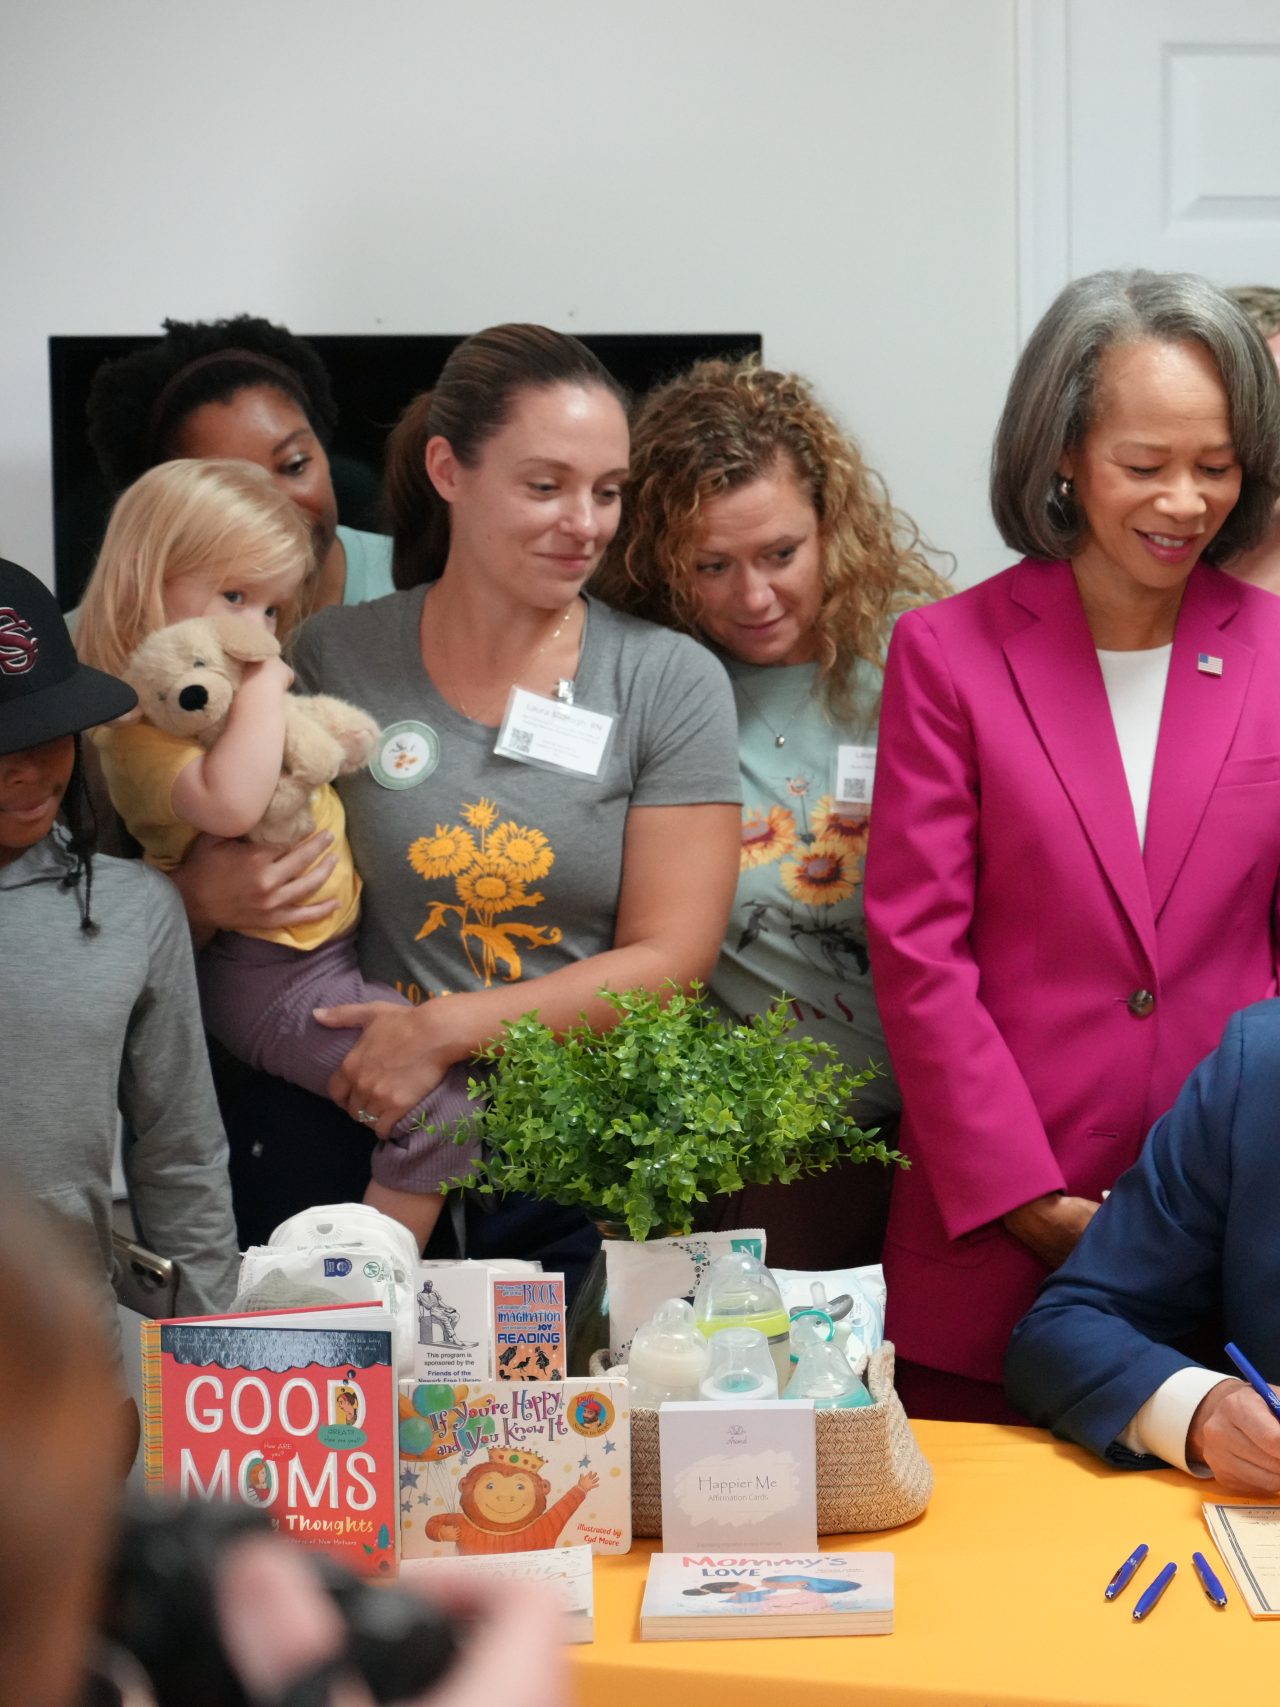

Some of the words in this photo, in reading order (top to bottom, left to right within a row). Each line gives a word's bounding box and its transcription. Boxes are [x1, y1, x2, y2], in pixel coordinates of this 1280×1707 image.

[523, 1284, 559, 1305] BOOK
[498, 1311, 560, 1322] IMAGINATION
[498, 1333, 560, 1343] READING
[185, 1375, 367, 1437] GOOD
[429, 1410, 448, 1438] If
[453, 1399, 510, 1430] You're
[512, 1389, 561, 1422] Happy
[437, 1431, 461, 1455] and
[463, 1426, 499, 1457] You
[503, 1417, 545, 1445] Know
[548, 1414, 568, 1441] It
[179, 1448, 378, 1511] MOMS
[698, 1475, 752, 1494] Happier
[755, 1475, 777, 1490] Me
[708, 1494, 747, 1502] Affirmation
[749, 1493, 769, 1501] Cards
[285, 1514, 374, 1535] Thoughts
[584, 1535, 597, 1544] Cyd
[598, 1537, 620, 1546] Moore
[613, 1529, 622, 1538] by
[682, 1556, 848, 1569] Mommy's
[702, 1568, 760, 1577] LOVE
